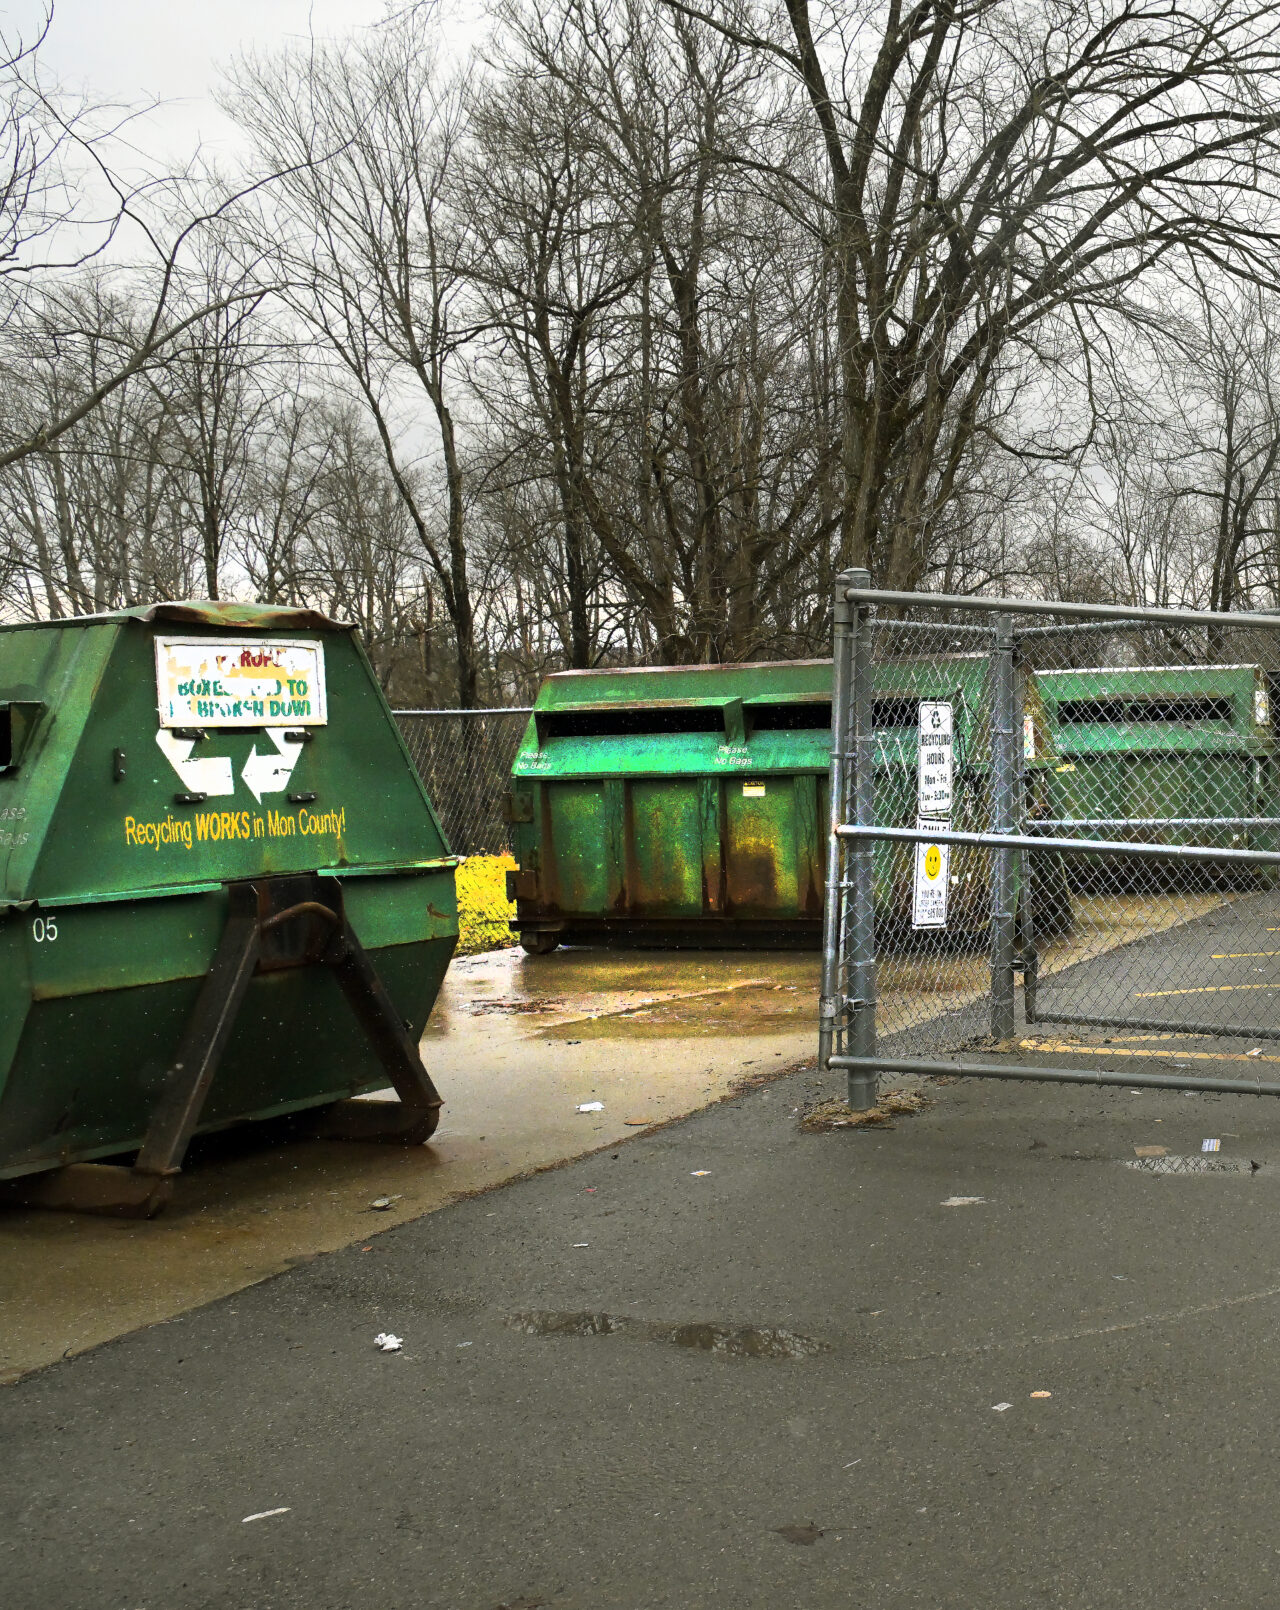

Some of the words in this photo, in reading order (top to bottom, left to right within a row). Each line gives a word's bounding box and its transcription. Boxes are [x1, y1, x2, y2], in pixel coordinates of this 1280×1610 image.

[178, 679, 232, 696] BOXE
[287, 679, 308, 696] TO
[921, 734, 951, 747] RECYCLING
[714, 757, 727, 766] No
[729, 756, 753, 767] Bags
[926, 752, 945, 765] HOURS
[125, 814, 193, 851] Recycling
[195, 811, 250, 841] WORKS
[253, 811, 265, 838] in
[267, 809, 296, 837] Mon
[298, 806, 347, 840] County!
[32, 916, 58, 943] 05
